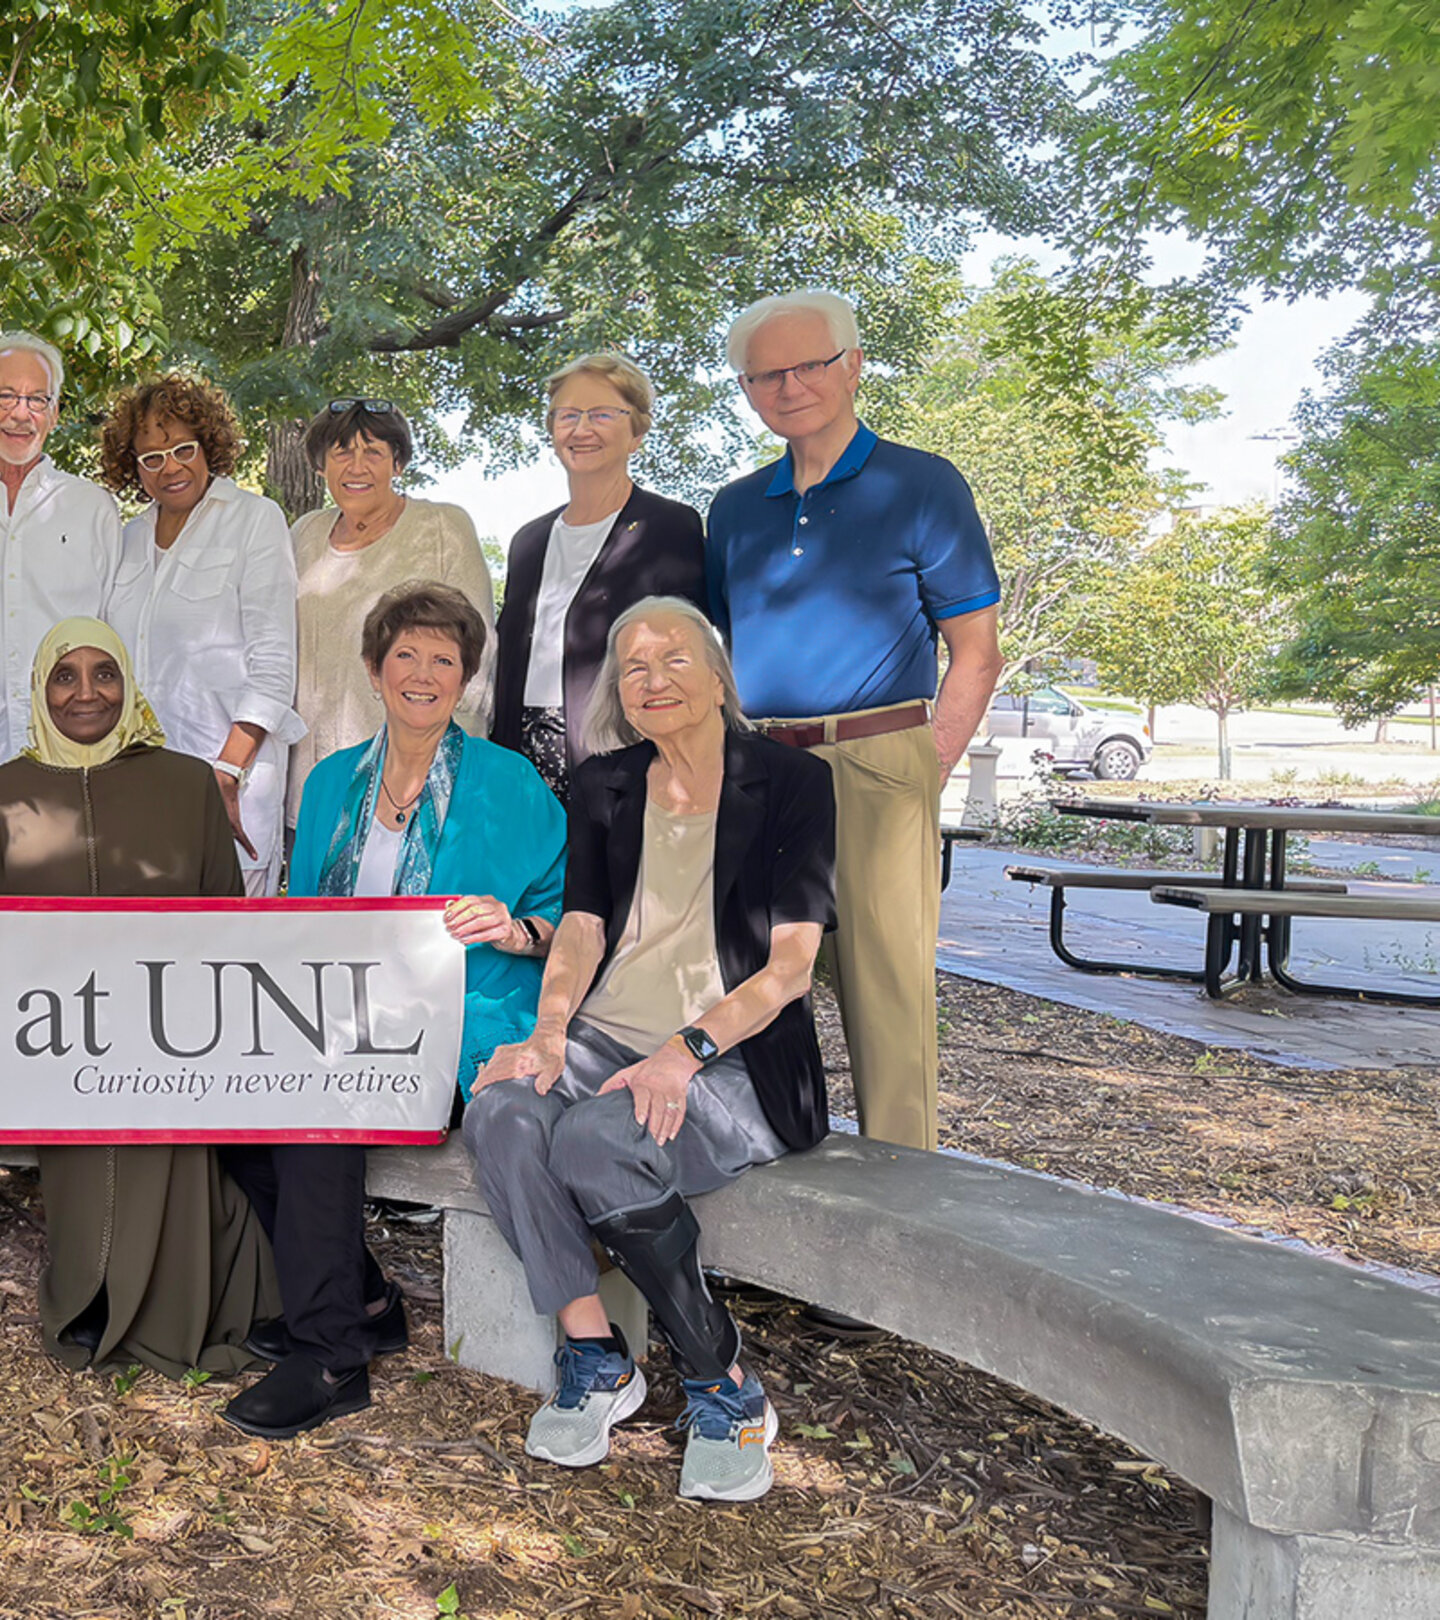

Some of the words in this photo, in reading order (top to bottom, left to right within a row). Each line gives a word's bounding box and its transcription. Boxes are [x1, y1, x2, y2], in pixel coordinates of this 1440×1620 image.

[16, 970, 111, 1057] at
[135, 960, 424, 1058] UNL
[73, 1065, 214, 1102] Curiosity
[225, 1074, 312, 1095] never
[323, 1066, 421, 1094] retires
